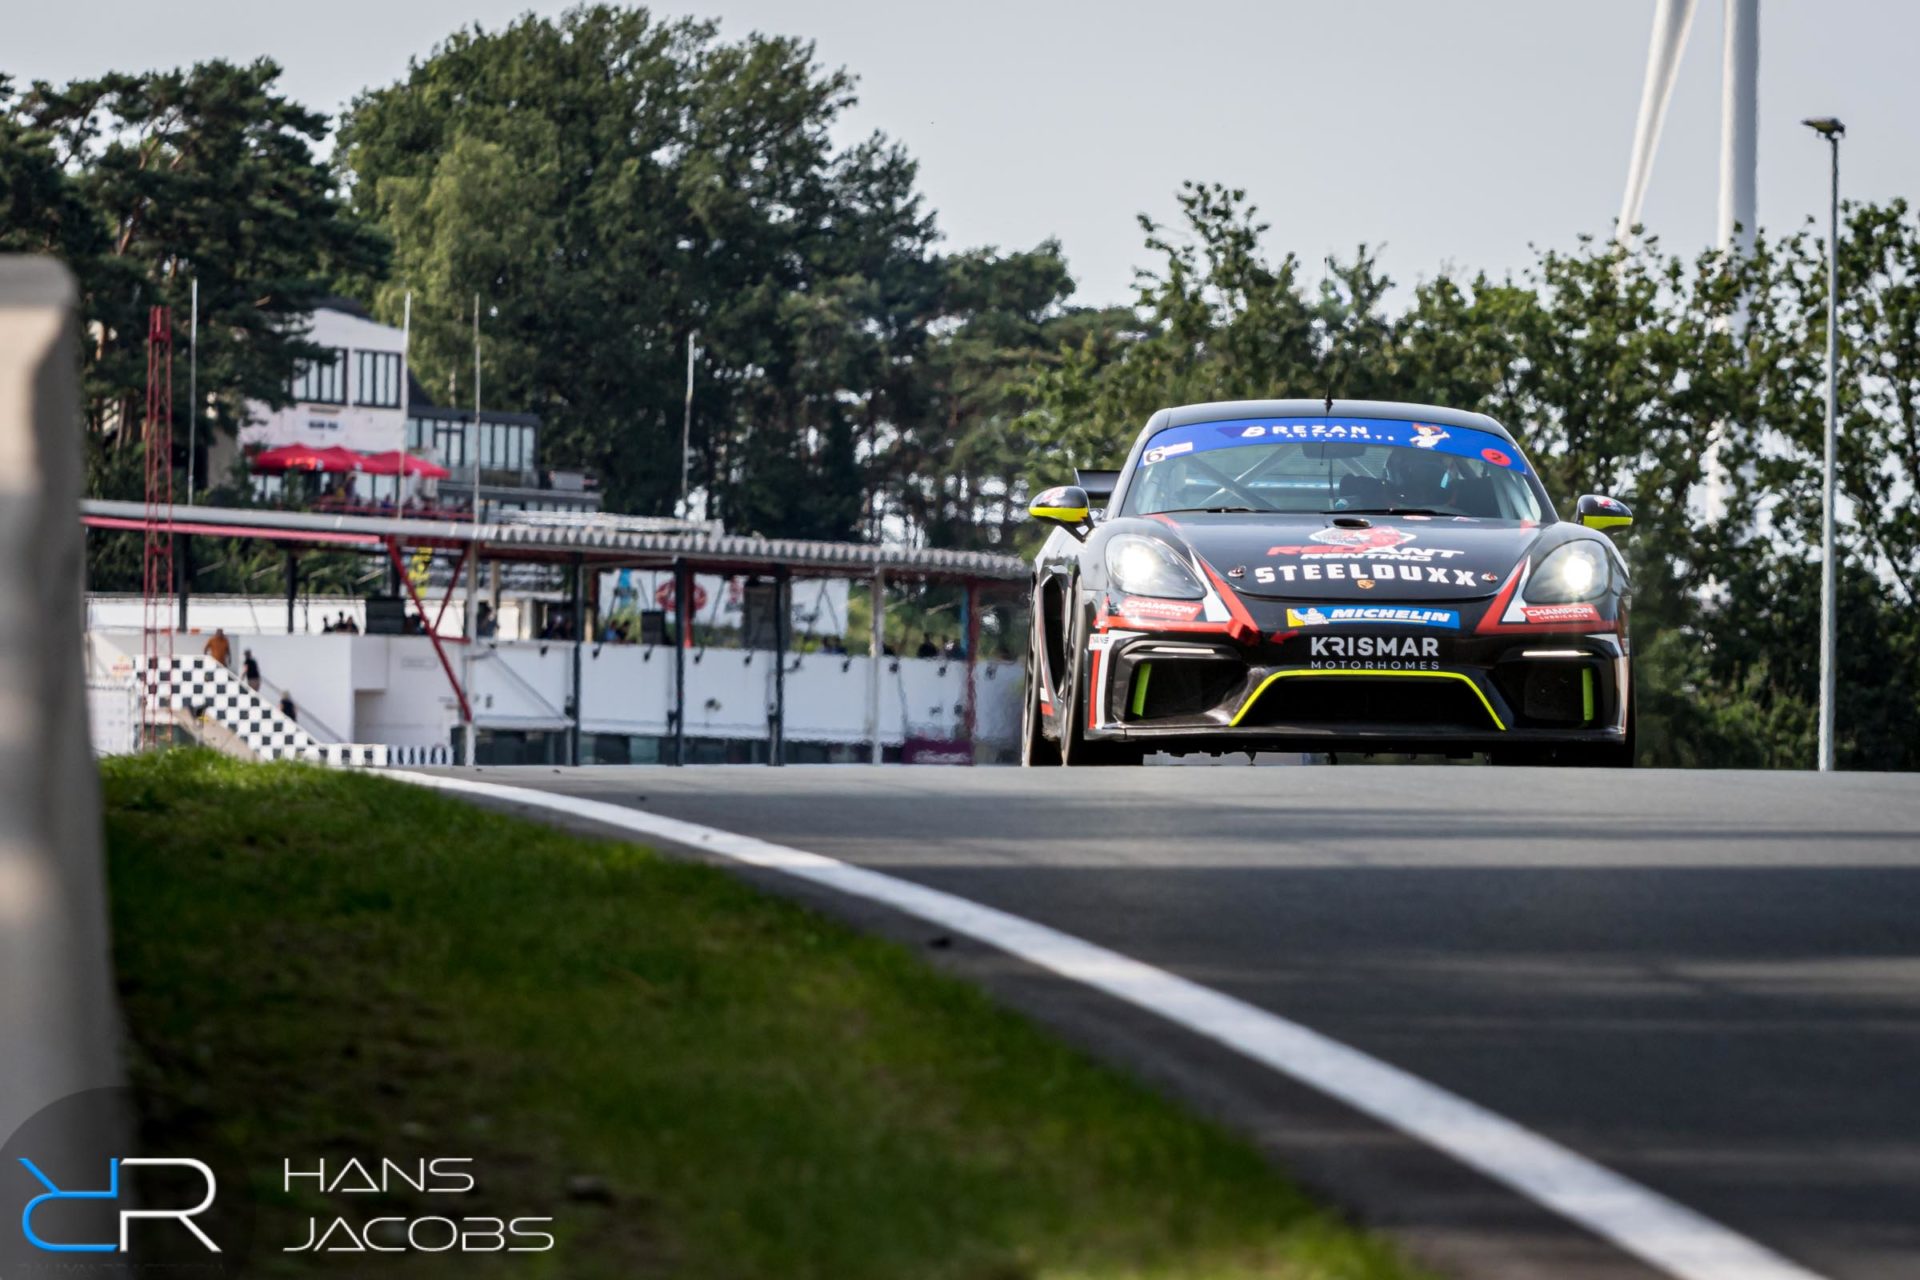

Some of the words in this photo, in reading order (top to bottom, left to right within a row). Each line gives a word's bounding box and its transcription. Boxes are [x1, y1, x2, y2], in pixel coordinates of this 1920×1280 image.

[1300, 553, 1432, 562] RENTING
[1254, 563, 1477, 587] STEELDUXX
[1125, 600, 1198, 614] CHAMPION
[1526, 606, 1594, 617] CHAMPION
[1330, 608, 1451, 622] MICHELIN
[1310, 636, 1439, 657] KRISMAR
[1310, 660, 1440, 671] MOTORHOMES
